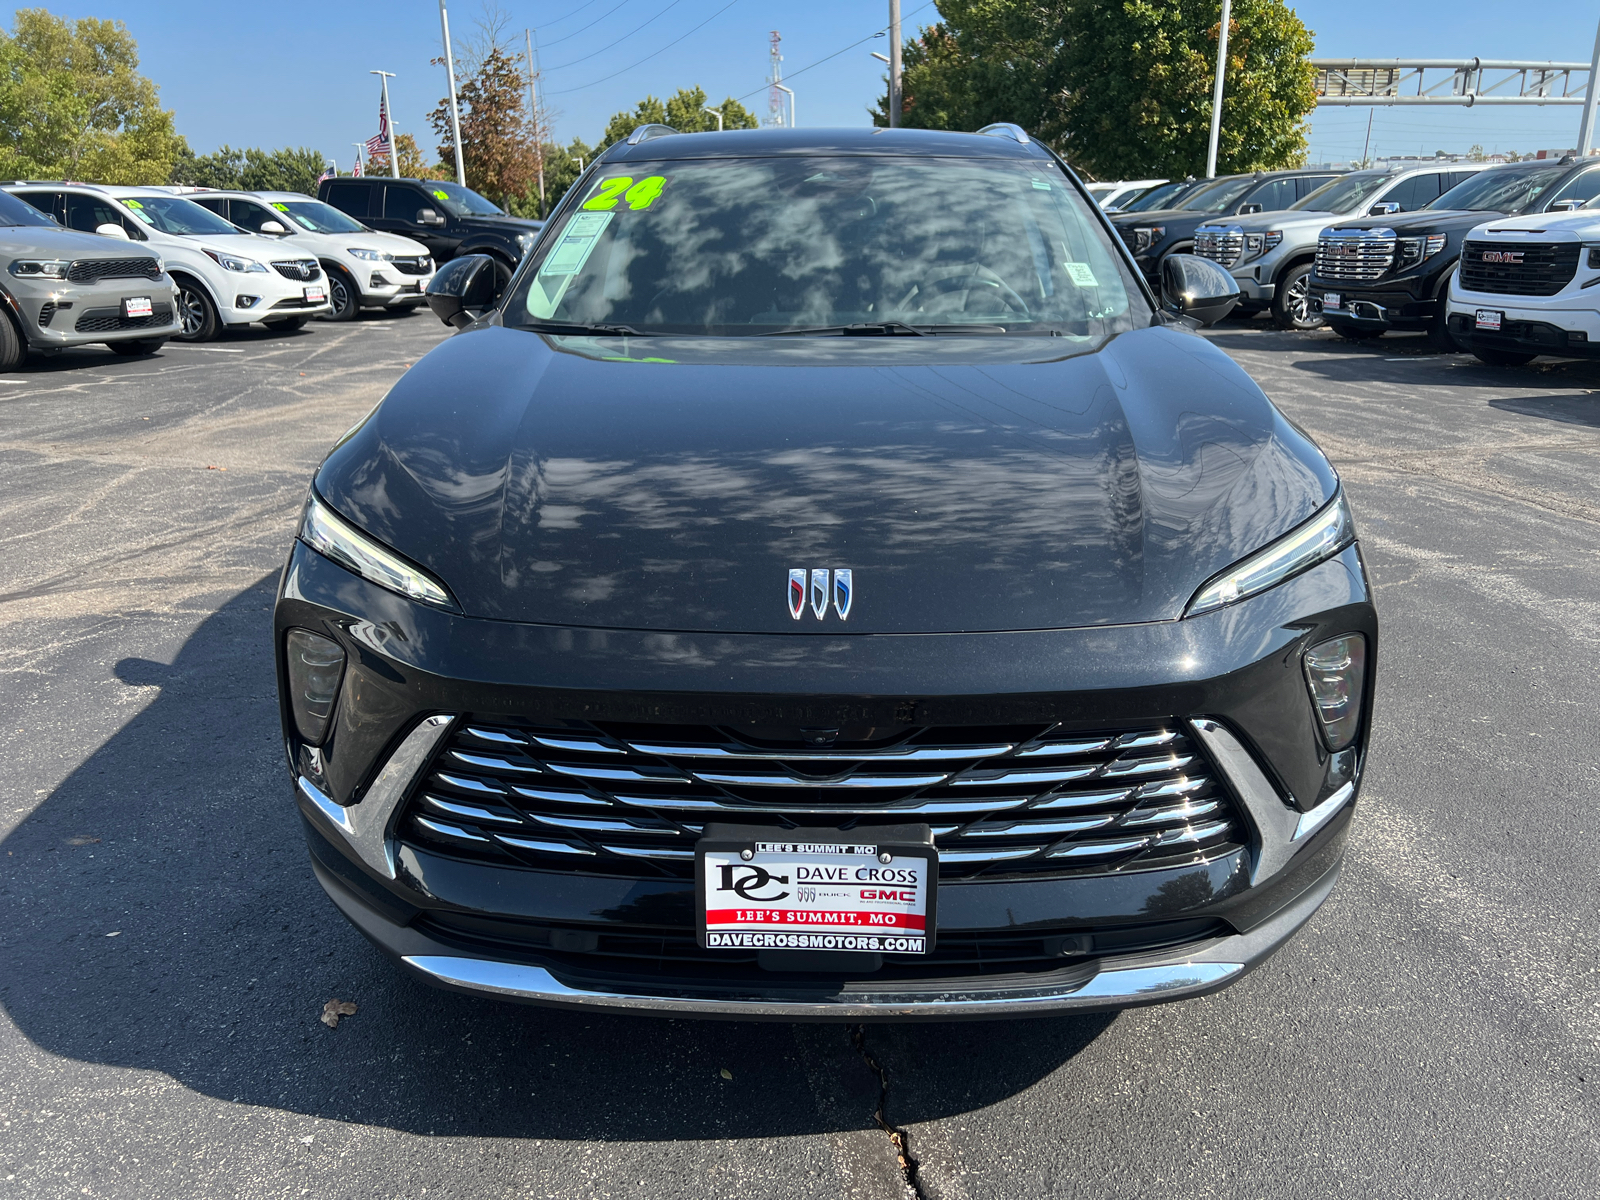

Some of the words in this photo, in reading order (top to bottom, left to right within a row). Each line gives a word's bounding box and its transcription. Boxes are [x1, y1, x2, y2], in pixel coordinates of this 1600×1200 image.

[582, 175, 668, 211] 24
[1482, 250, 1525, 263] GMC
[758, 843, 794, 853] LEE'S
[796, 844, 848, 854] SUMMIT
[854, 845, 875, 855] MO
[796, 867, 849, 881] DAVE
[855, 868, 918, 884] CROSS
[859, 889, 917, 902] GMC
[786, 911, 862, 926] SUMMIT,
[868, 913, 897, 925] MO
[709, 934, 923, 952] DAVECROSSMOTORS.COM
